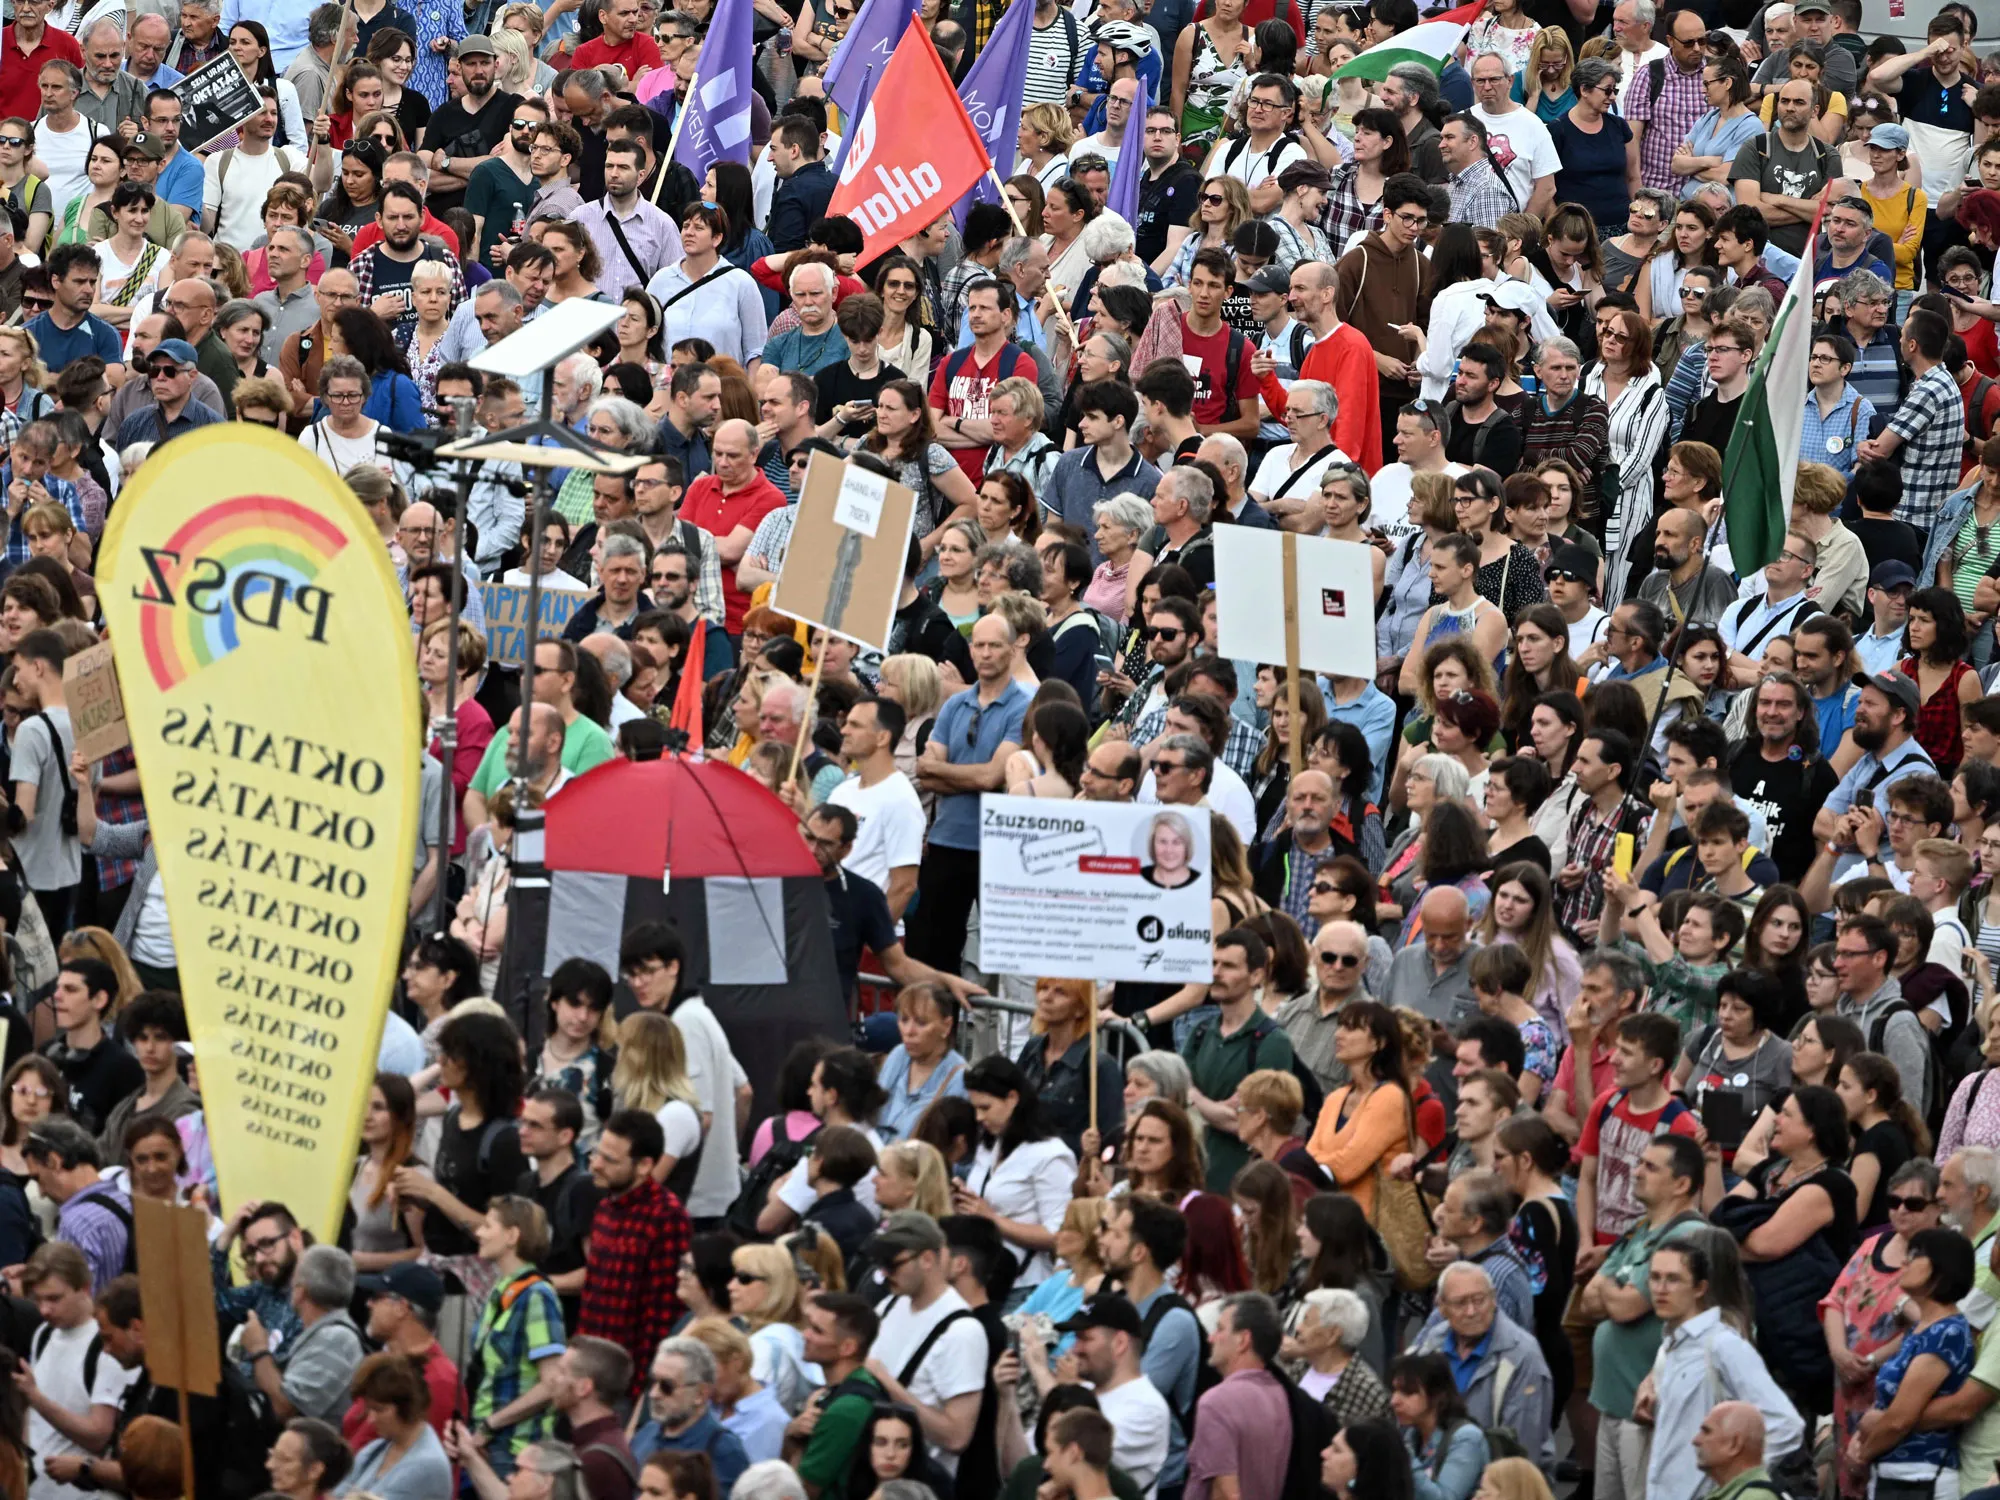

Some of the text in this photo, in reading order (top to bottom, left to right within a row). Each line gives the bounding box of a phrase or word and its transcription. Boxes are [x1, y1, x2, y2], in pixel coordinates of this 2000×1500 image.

[190, 59, 230, 89] SZIA URAM!
[192, 69, 240, 105] OKTATÁS
[405, 312, 420, 320] YOR
[478, 586, 586, 625] APITÁNY
[1752, 780, 1766, 796] A
[983, 808, 1085, 834] Zsuzsanna
